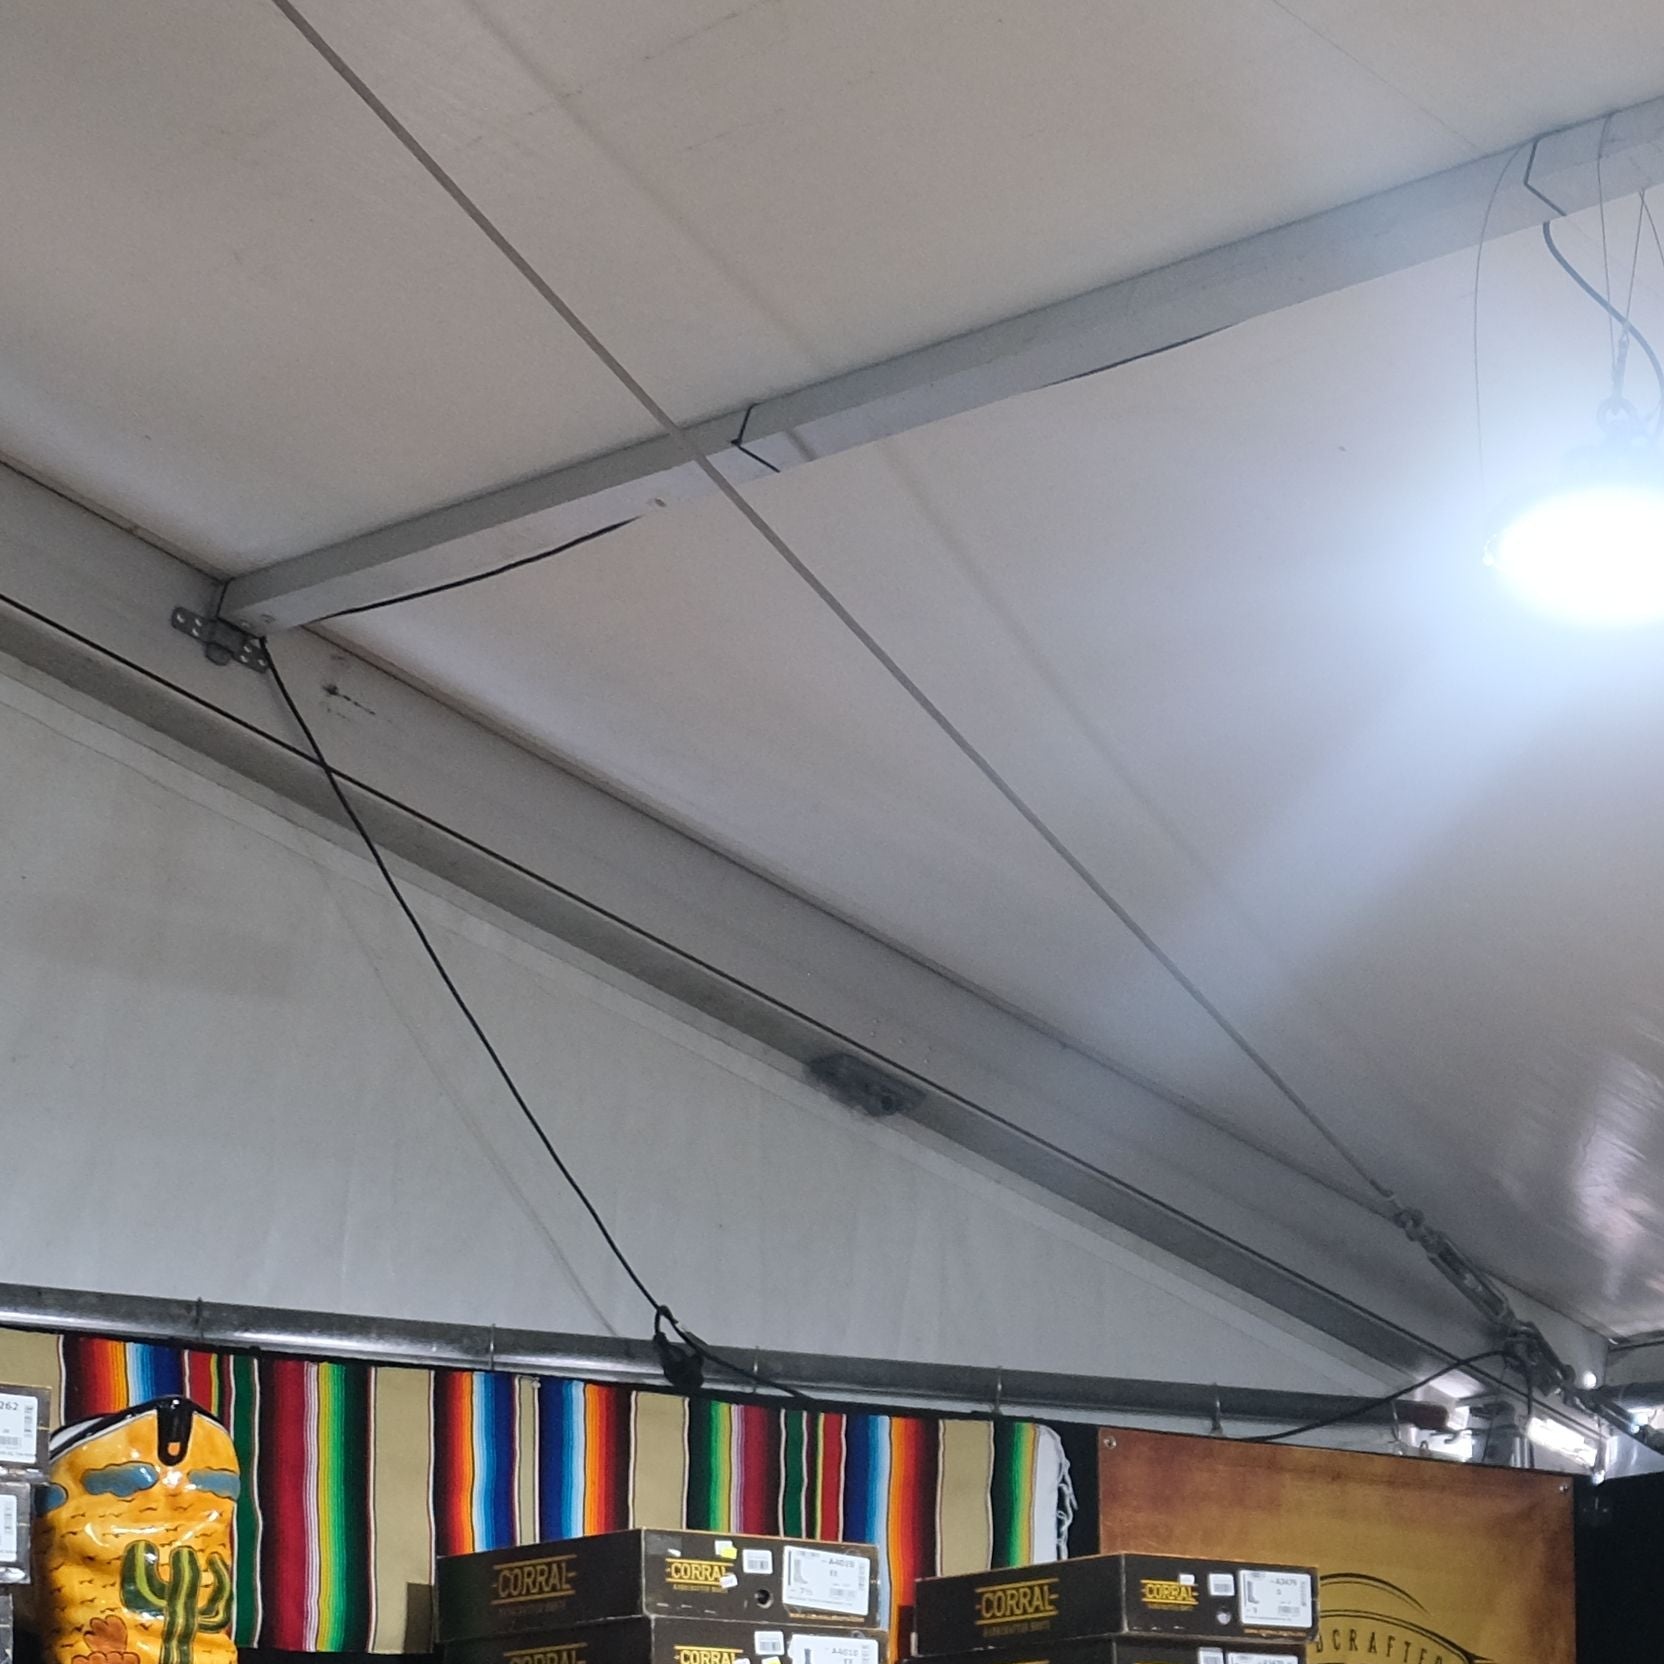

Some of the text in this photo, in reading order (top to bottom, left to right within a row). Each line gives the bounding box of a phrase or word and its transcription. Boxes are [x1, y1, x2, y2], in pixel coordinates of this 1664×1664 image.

[499, 1560, 571, 1594] CORRAL
[981, 1589, 1053, 1619] CORRAL
[1145, 1585, 1193, 1602] CORRAL
